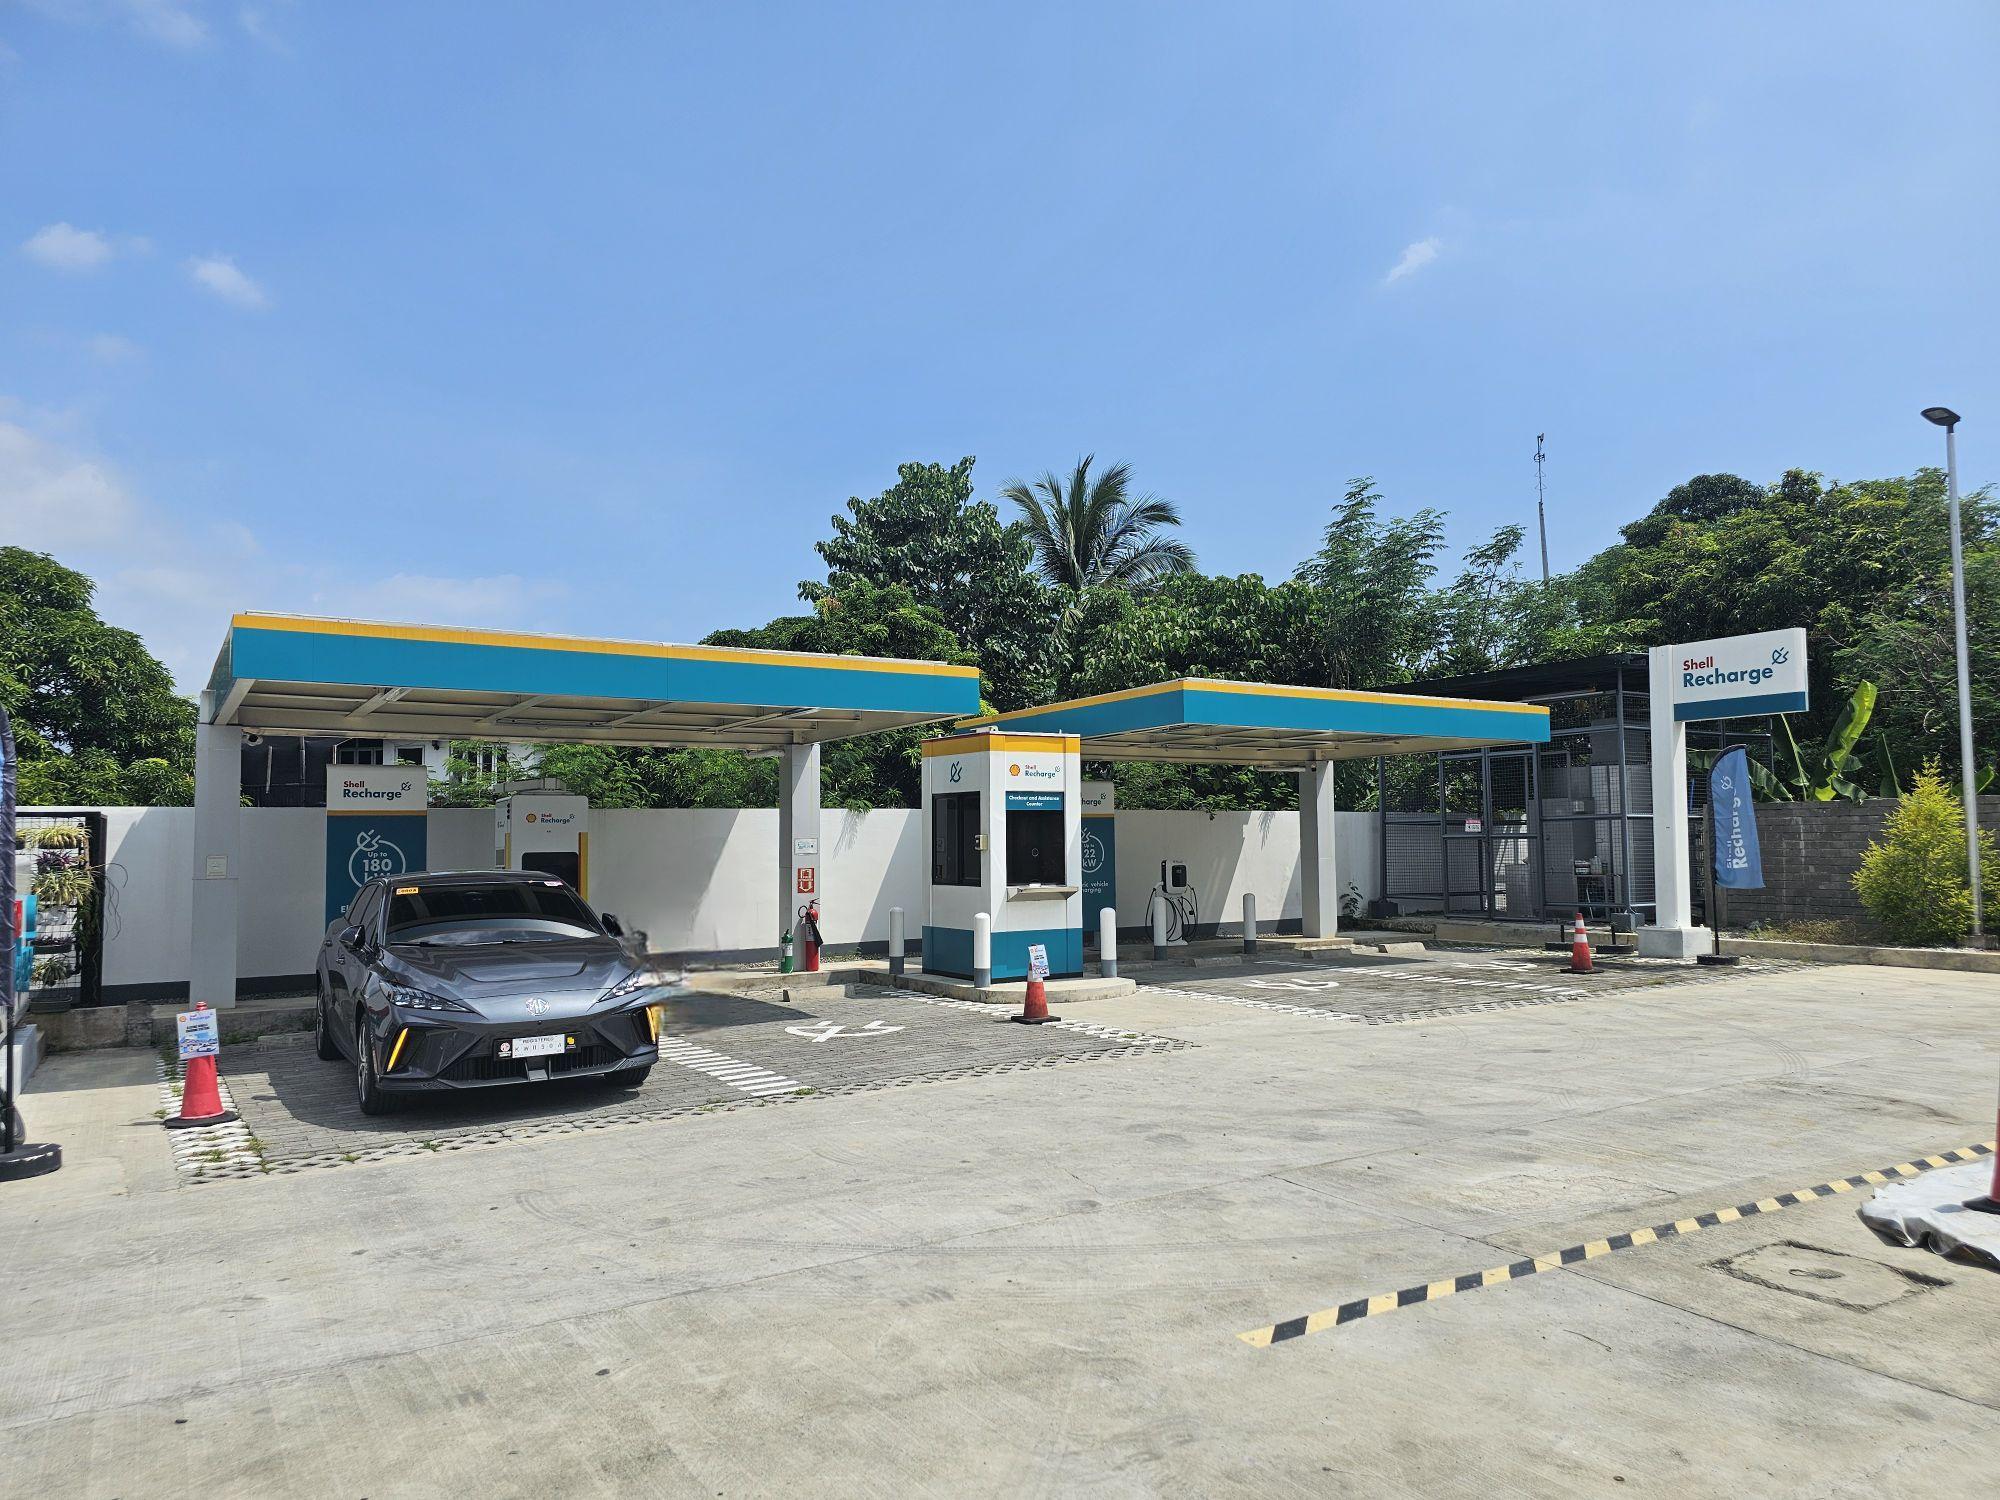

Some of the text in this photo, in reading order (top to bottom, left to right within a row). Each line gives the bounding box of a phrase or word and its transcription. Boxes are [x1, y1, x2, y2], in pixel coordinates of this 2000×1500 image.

[1683, 656, 1714, 671] Shell
[1683, 667, 1774, 688] Recharge
[1024, 769, 1056, 778] Recharge
[343, 780, 365, 788] Shell
[343, 788, 402, 801] Recharge
[1081, 798, 1102, 807] harge
[540, 817, 571, 825] Recharge
[1731, 788, 1749, 869] Recharg
[367, 851, 378, 859] Up
[1083, 849, 1096, 858] 22
[362, 859, 393, 872] 180
[1082, 858, 1097, 867] kW
